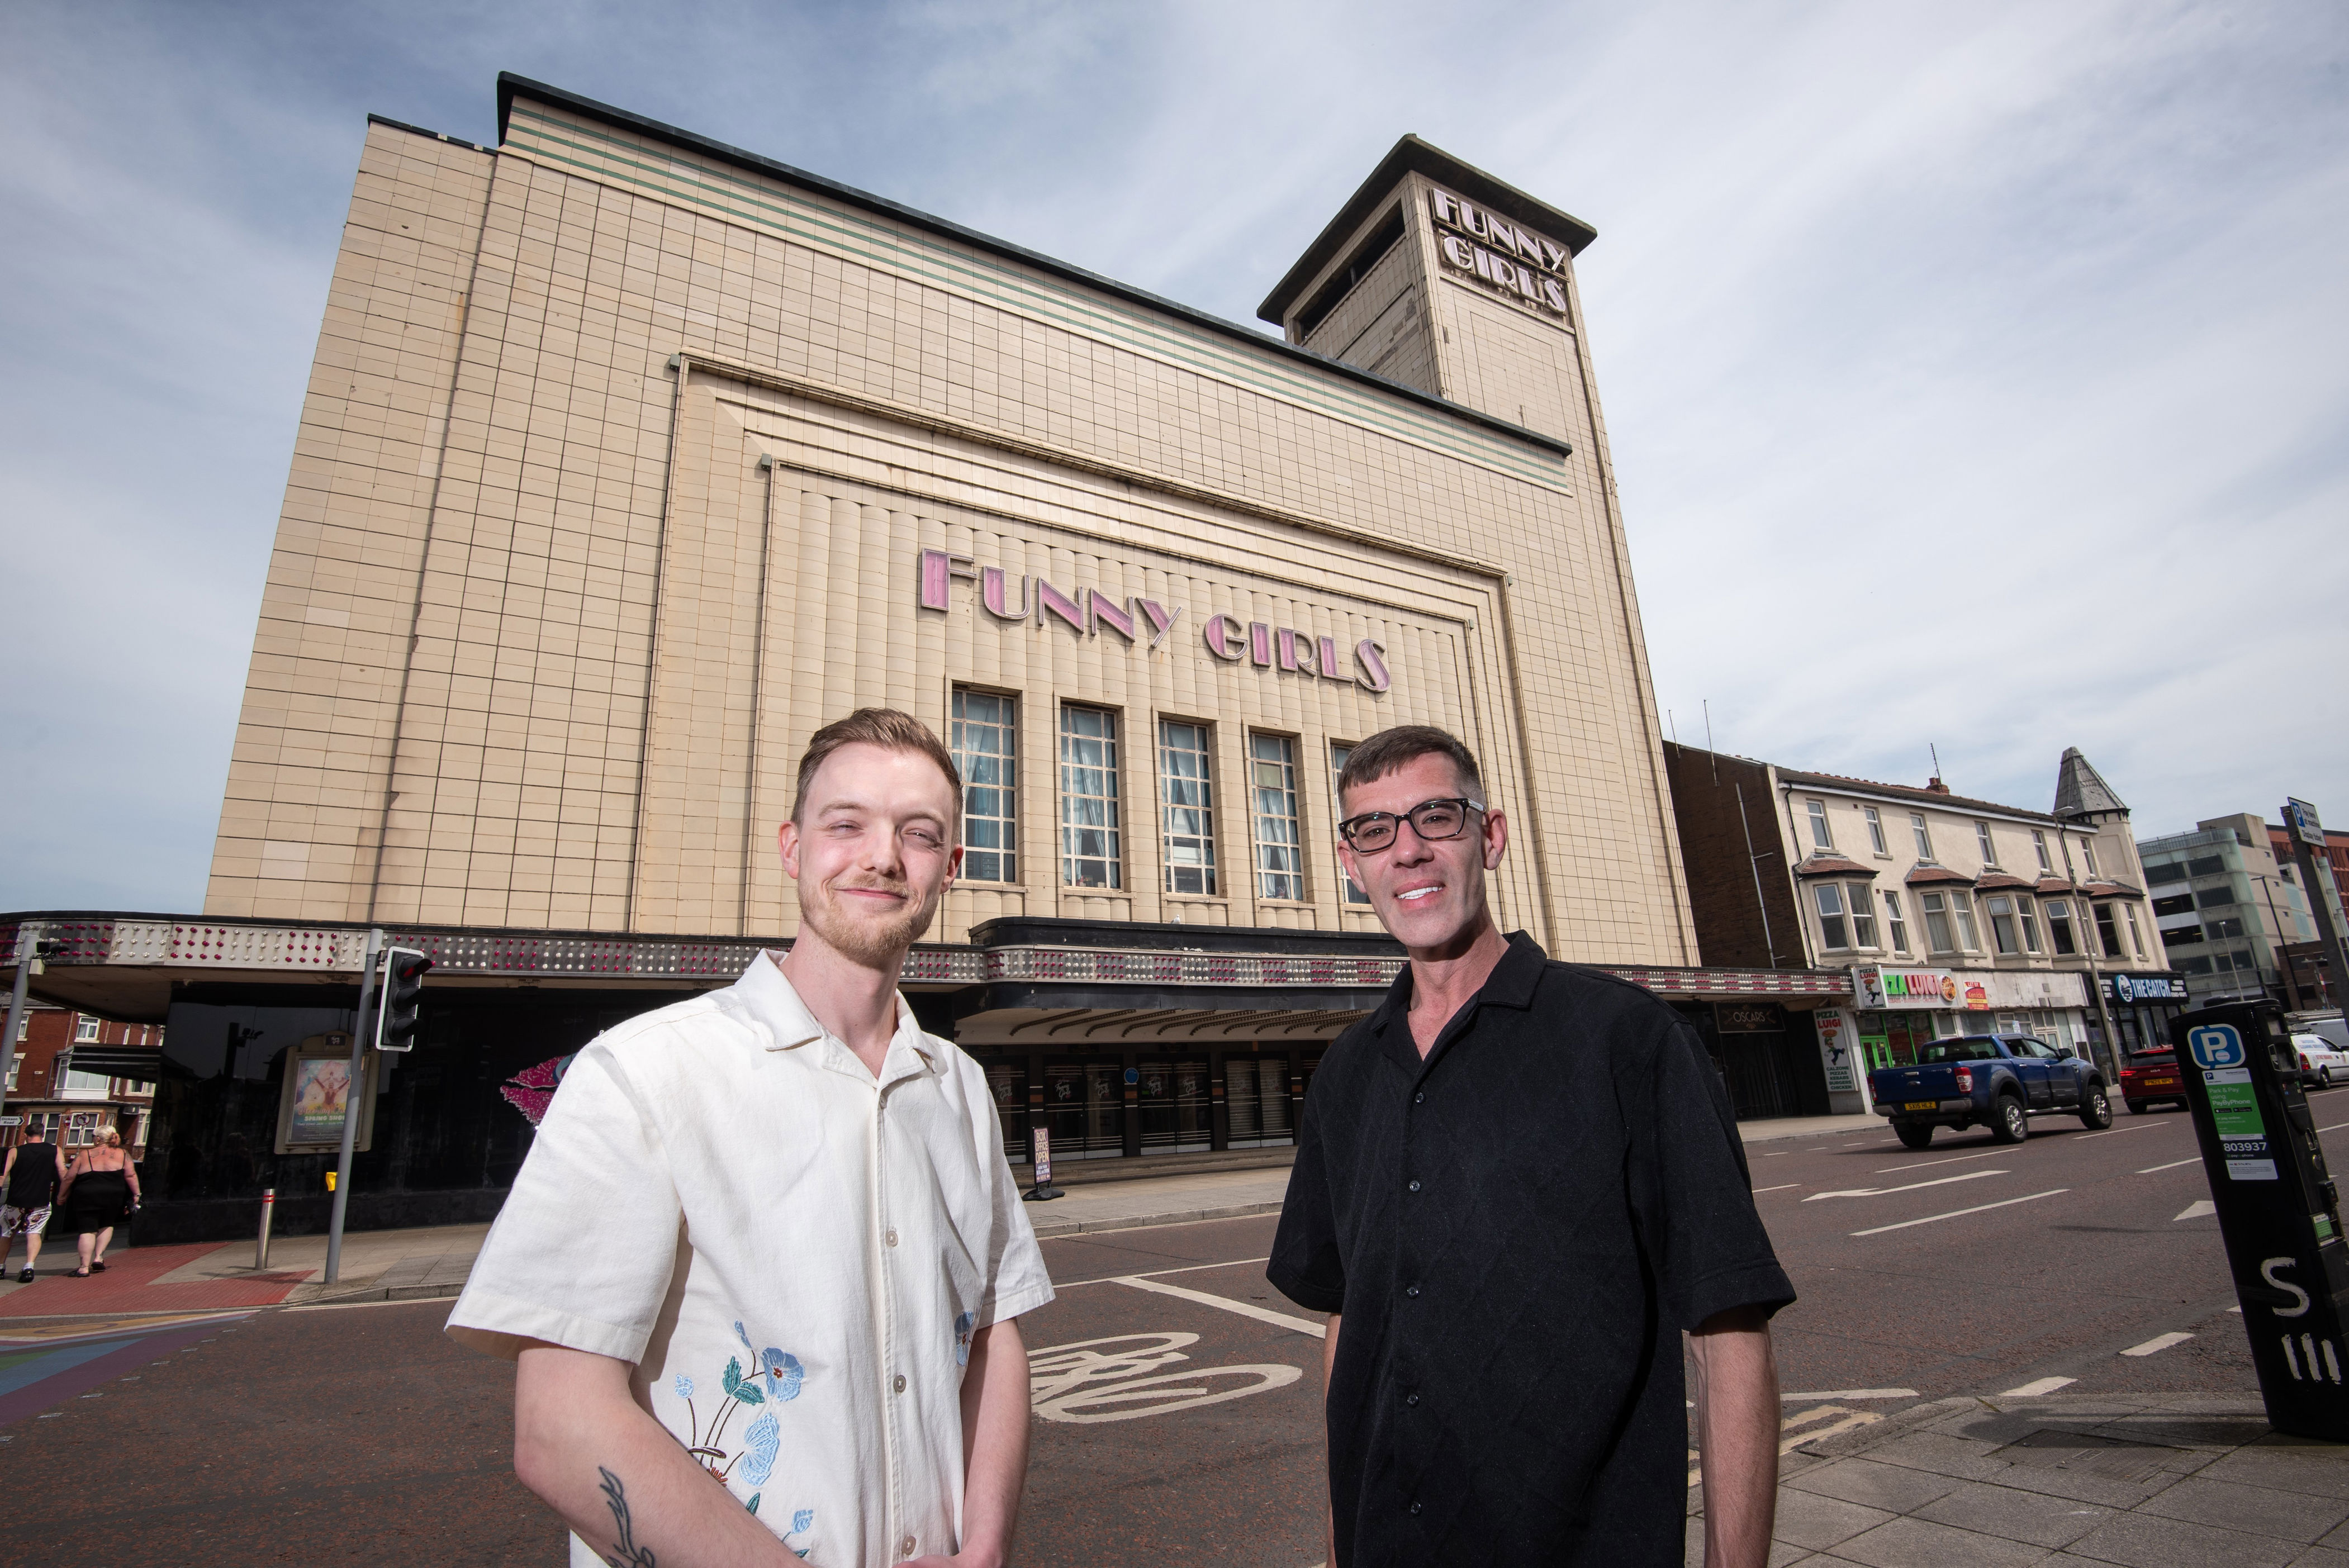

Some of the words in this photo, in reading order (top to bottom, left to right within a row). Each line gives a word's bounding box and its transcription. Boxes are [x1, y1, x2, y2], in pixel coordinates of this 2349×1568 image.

[1432, 188, 1565, 272] FUNNY
[1444, 236, 1565, 312] GIRLS
[921, 547, 1183, 648] FUNNY
[1204, 612, 1392, 692] GIRLS
[2301, 830, 2314, 840] Display
[2313, 833, 2323, 842] ticket
[1883, 975, 1909, 994] ZZA
[1904, 975, 1940, 994] LUIGI
[2130, 980, 2148, 997] THE
[2145, 980, 2171, 997] CATCH
[1733, 1011, 1766, 1022] OSCARS
[1816, 1010, 1839, 1019] PIZZA
[1817, 1018, 1842, 1029] LUIGI
[2200, 1032, 2228, 1062] P
[1036, 1131, 1046, 1142] BOX
[1036, 1142, 1048, 1152] OFFICE
[2223, 1142, 2267, 1151] 803937
[1036, 1151, 1049, 1163] OPEN
[2260, 1257, 2311, 1318] S
